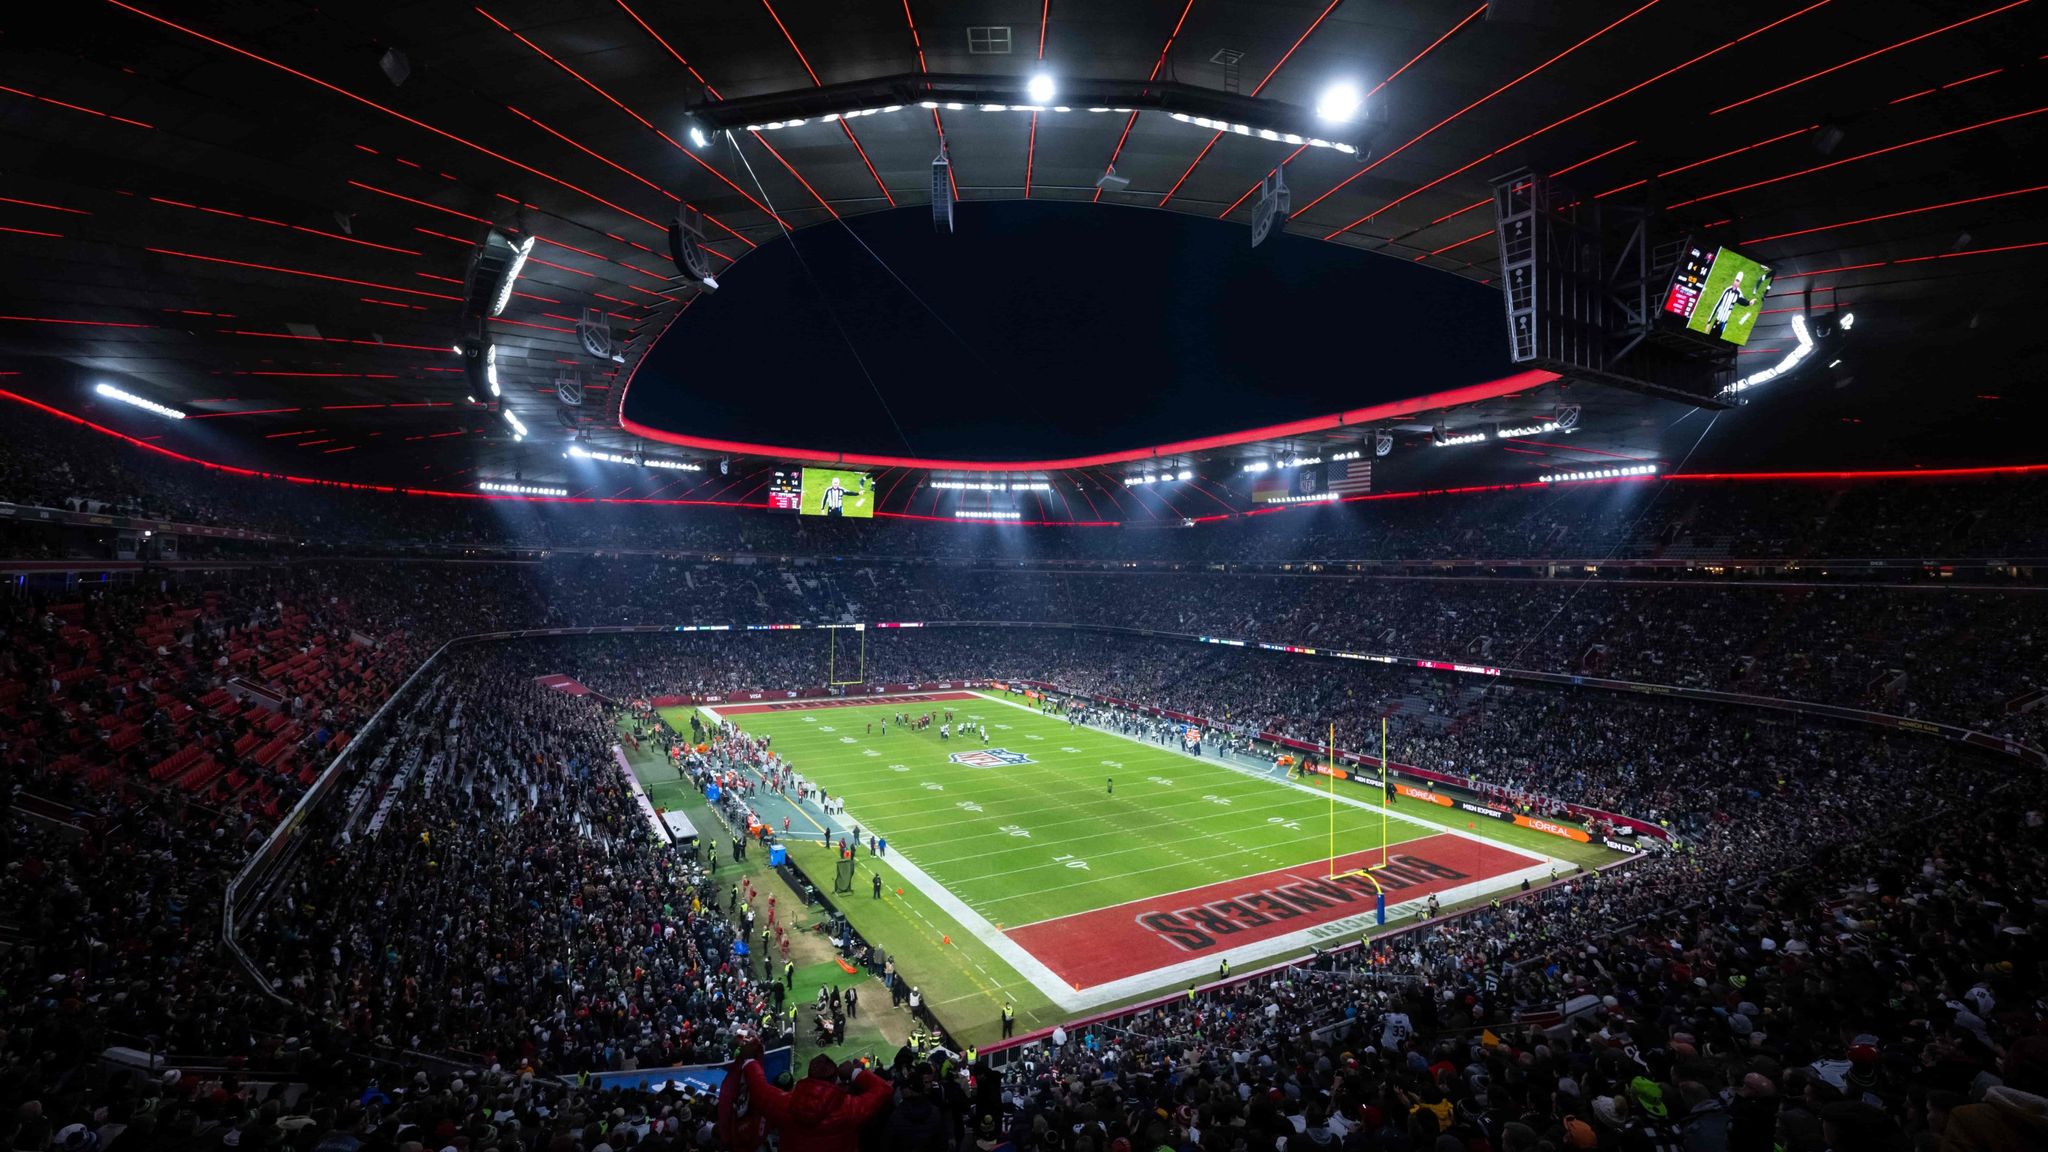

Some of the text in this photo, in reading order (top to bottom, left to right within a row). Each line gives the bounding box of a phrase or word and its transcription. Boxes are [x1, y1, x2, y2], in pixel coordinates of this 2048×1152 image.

[1462, 803, 1476, 812] MEN
[1477, 806, 1502, 818] EXPERT
[1393, 1025, 1405, 1037] 33
